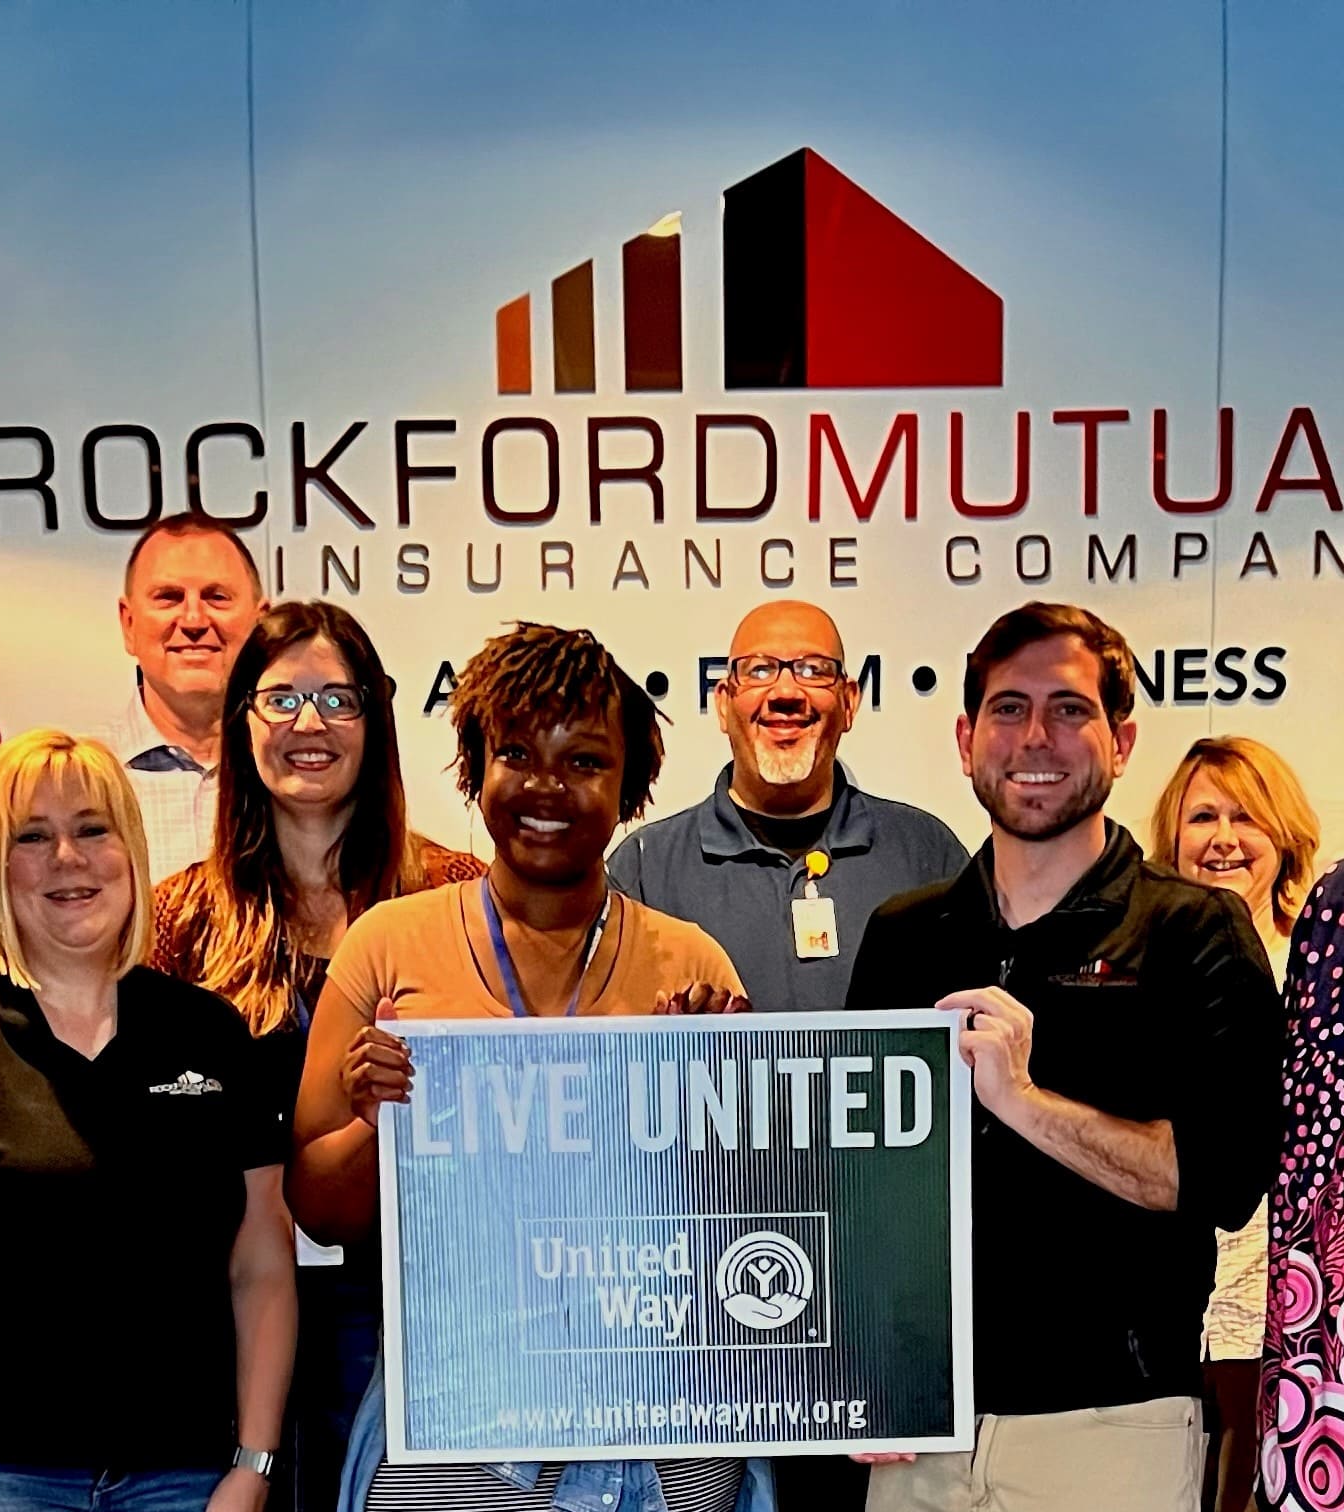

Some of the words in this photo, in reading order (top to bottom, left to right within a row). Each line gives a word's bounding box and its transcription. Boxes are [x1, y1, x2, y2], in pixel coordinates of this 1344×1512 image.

[274, 537, 859, 596] INSURANCE
[409, 1061, 593, 1158] LIVE
[626, 1054, 933, 1155] UNITED
[530, 1232, 694, 1281] United
[596, 1285, 694, 1341] Way
[497, 1397, 868, 1432] www.unitedwayrrv.org
